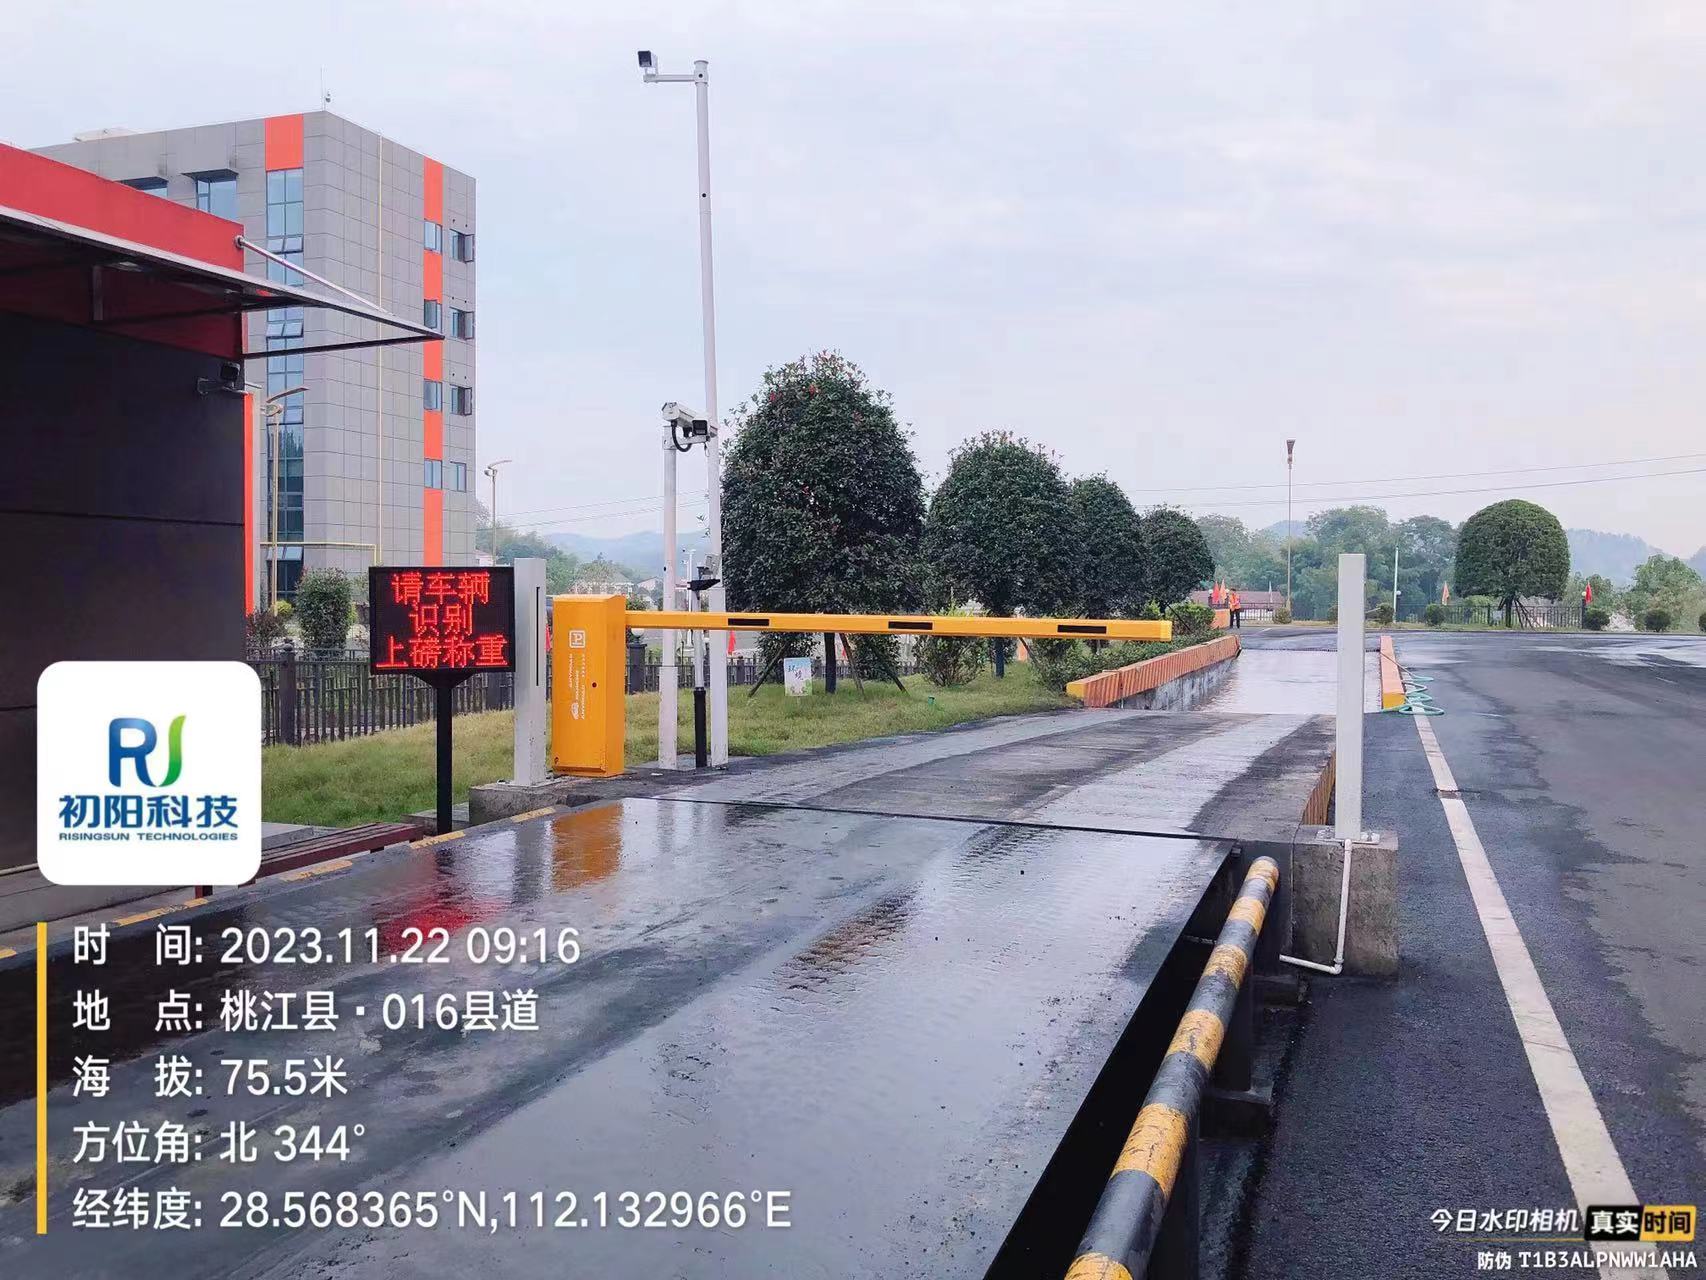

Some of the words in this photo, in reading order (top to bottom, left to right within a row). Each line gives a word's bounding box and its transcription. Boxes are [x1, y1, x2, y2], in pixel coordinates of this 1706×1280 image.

[390, 571, 490, 605] 请车辆
[408, 604, 473, 636] 识别
[376, 634, 508, 669] 上磅称重
